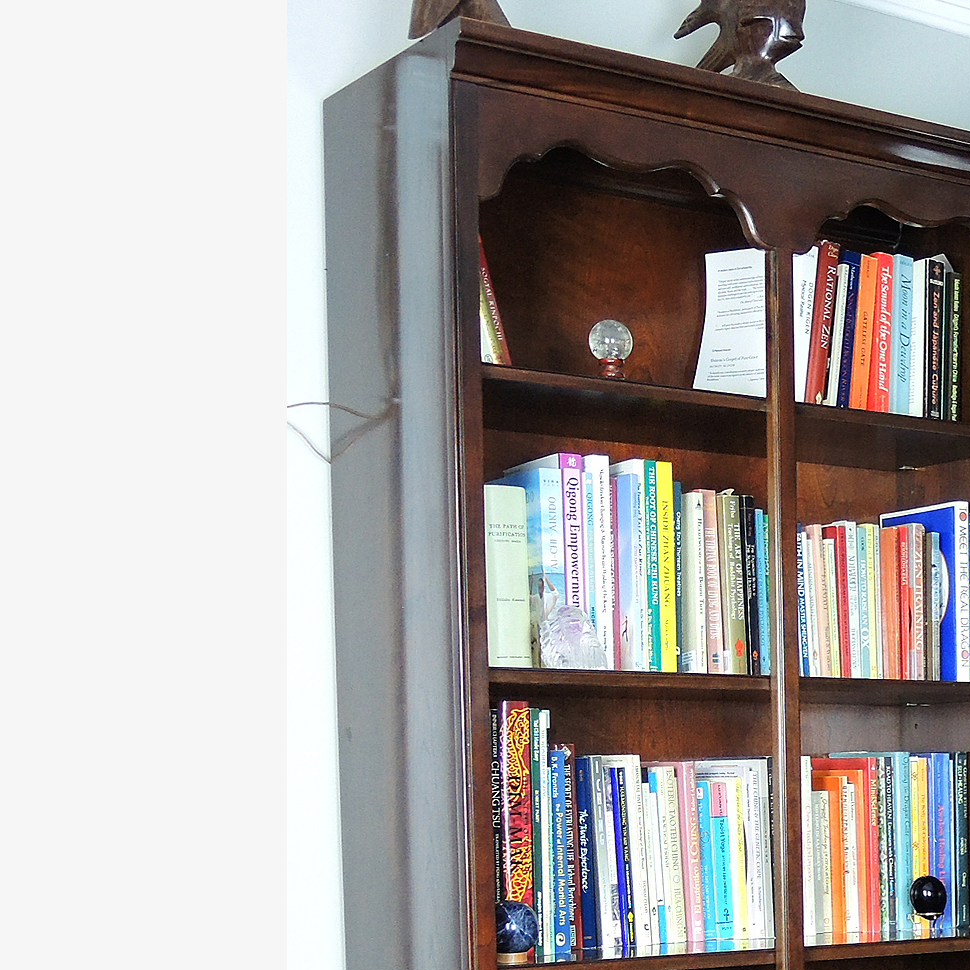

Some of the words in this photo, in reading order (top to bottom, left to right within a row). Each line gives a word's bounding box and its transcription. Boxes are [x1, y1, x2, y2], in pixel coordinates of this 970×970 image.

[880, 266, 891, 284] The
[822, 265, 836, 321] RATIONAL
[879, 284, 890, 312] Sound
[900, 273, 911, 307] Moon
[820, 325, 832, 349] ZEN
[879, 340, 889, 360] One
[930, 330, 940, 370] Japanese
[897, 333, 910, 383] Dewdrop
[878, 362, 889, 391] Hand
[931, 374, 939, 405] Culture
[648, 466, 656, 484] THE
[565, 477, 579, 521] Qigong
[586, 492, 594, 526] QIGONG
[649, 485, 657, 509] ROOT
[661, 500, 669, 531] INSIDE
[649, 524, 658, 561] CHINESE
[662, 534, 670, 563] ZHAN
[796, 533, 804, 557] FAITH
[959, 526, 968, 556] MEET
[567, 524, 580, 608] Empowermen
[650, 563, 658, 577] CHI
[915, 551, 923, 579] ZEN
[960, 562, 969, 581] THE
[650, 579, 659, 605] KUNG
[663, 564, 671, 607] ZHUANG
[735, 577, 745, 620] HAPPINESS
[960, 586, 968, 613] REAL
[729, 590, 738, 620] Psychology
[861, 627, 869, 649] OX
[960, 618, 969, 667] DRAGON
[491, 761, 500, 802] CHUANG
[492, 805, 501, 829] TSU
[555, 812, 565, 839] Power
[666, 770, 676, 809] ESOTERIC
[671, 841, 679, 871] CHING
[718, 819, 727, 839] Taoist
[557, 844, 566, 876] Internal
[558, 878, 567, 907] Martial
[559, 909, 567, 926] Arts
